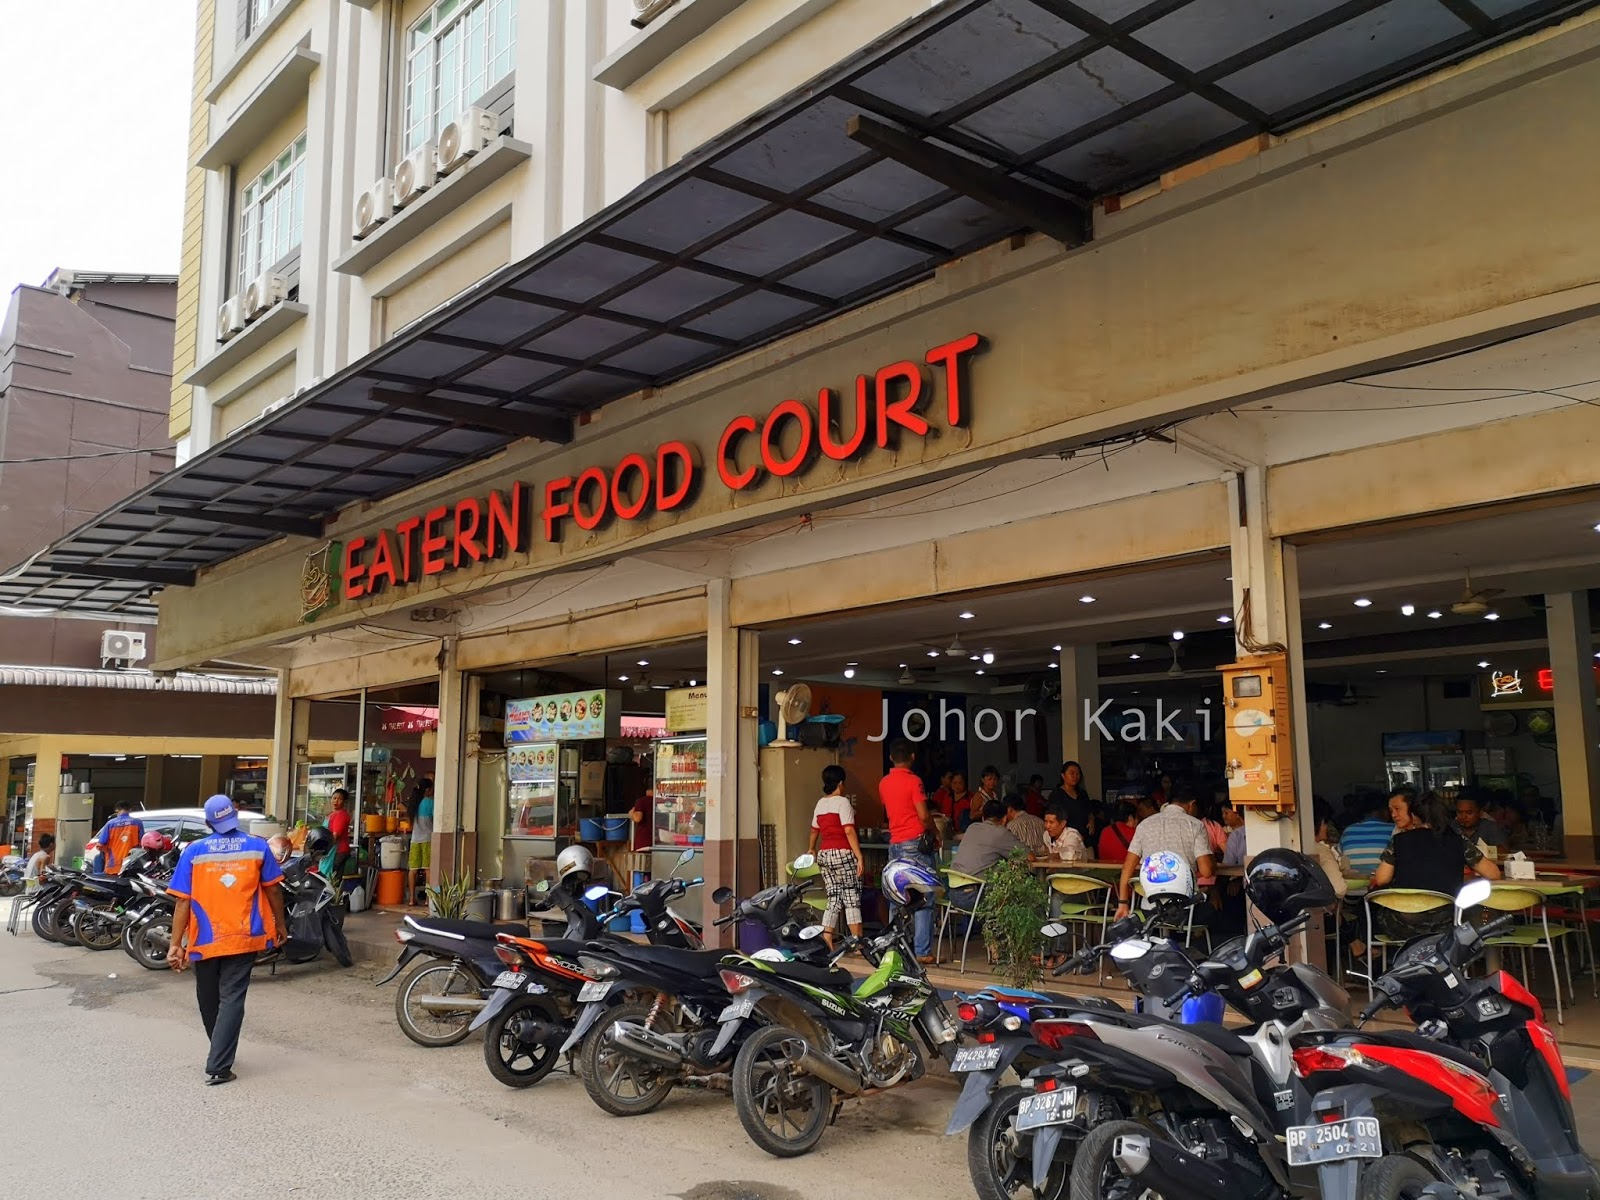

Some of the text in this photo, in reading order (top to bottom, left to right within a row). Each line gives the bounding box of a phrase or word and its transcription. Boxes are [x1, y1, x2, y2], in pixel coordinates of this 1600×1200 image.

[343, 332, 981, 600] EATERN FOOD COURT
[821, 998, 846, 1017] SUZUKI
[1020, 1090, 1074, 1114] BP 3267 JM
[1289, 1131, 1307, 1147] BP
[1316, 1123, 1349, 1144] 2504
